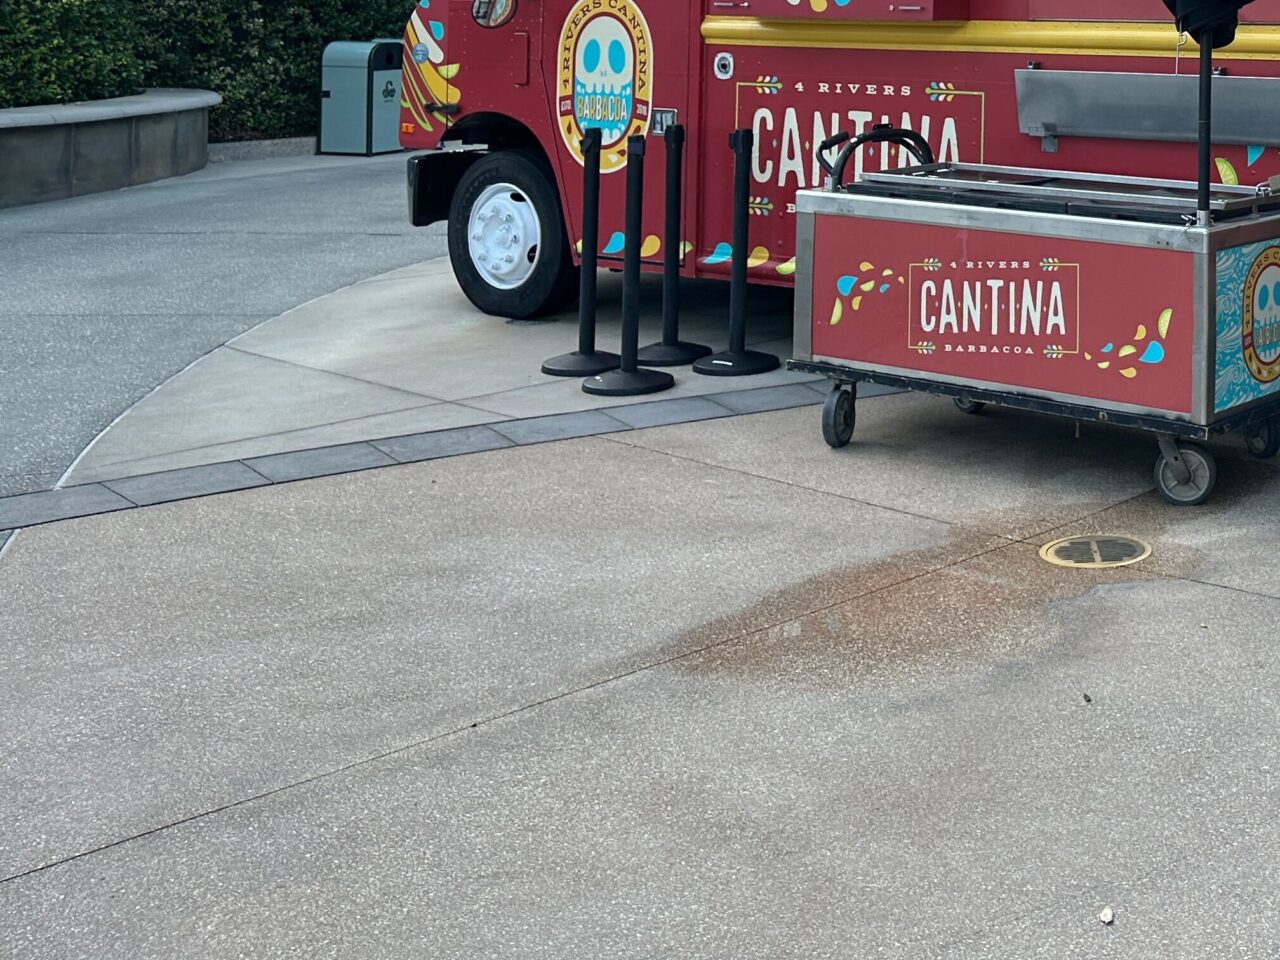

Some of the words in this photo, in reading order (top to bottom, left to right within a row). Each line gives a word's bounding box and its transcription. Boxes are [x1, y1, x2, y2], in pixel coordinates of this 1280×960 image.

[562, 81, 570, 89] 4
[794, 81, 804, 92] 4
[818, 82, 912, 97] RIVERS
[577, 94, 628, 122] BARBACOA
[752, 106, 960, 188] CANTINA
[950, 261, 957, 269] 4
[966, 261, 1030, 269] RIVERS
[1246, 254, 1270, 319] RIVERS
[920, 278, 1066, 336] CANTINA
[944, 344, 1034, 354] BARBACOA
